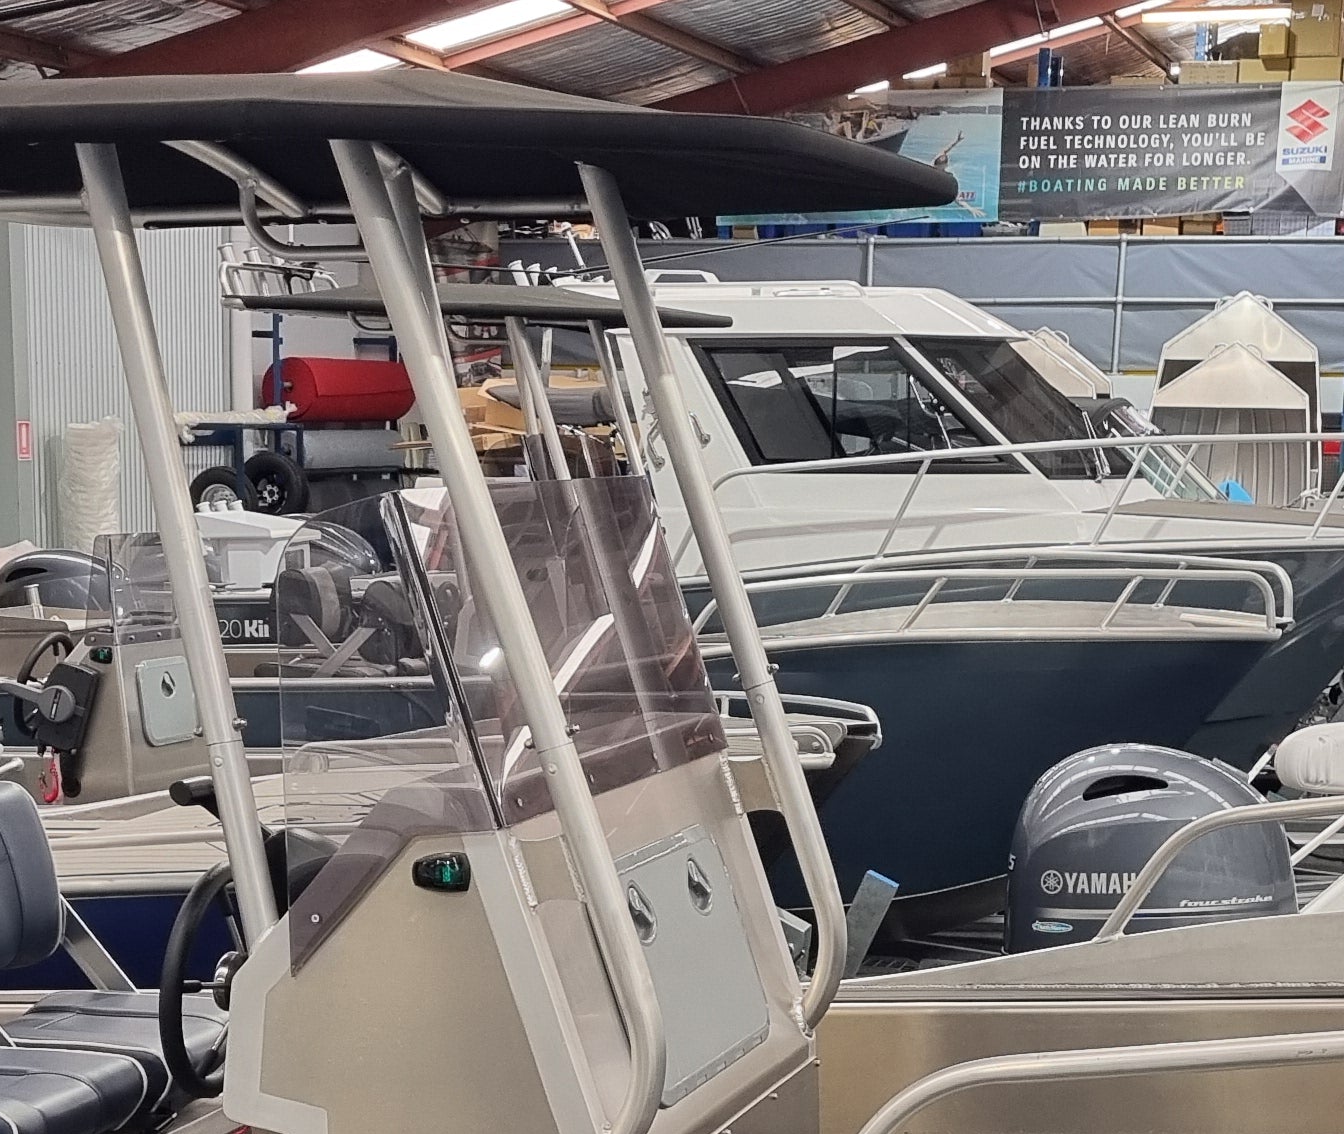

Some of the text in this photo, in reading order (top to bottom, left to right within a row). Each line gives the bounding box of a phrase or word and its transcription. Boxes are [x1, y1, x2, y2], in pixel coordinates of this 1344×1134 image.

[1020, 113, 1251, 130] THANKS TO OUR LEAN BURN
[1019, 131, 1266, 150] FUEL TECHNOLOGY, YOU'LL BE
[1281, 145, 1328, 156] SUZUKI
[1019, 151, 1251, 169] ON THE WATER FOR LONGER.
[1287, 156, 1323, 164] MARINE
[1017, 176, 1245, 193] #BOATING MADE BETTER
[1064, 872, 1140, 895] YAMAH
